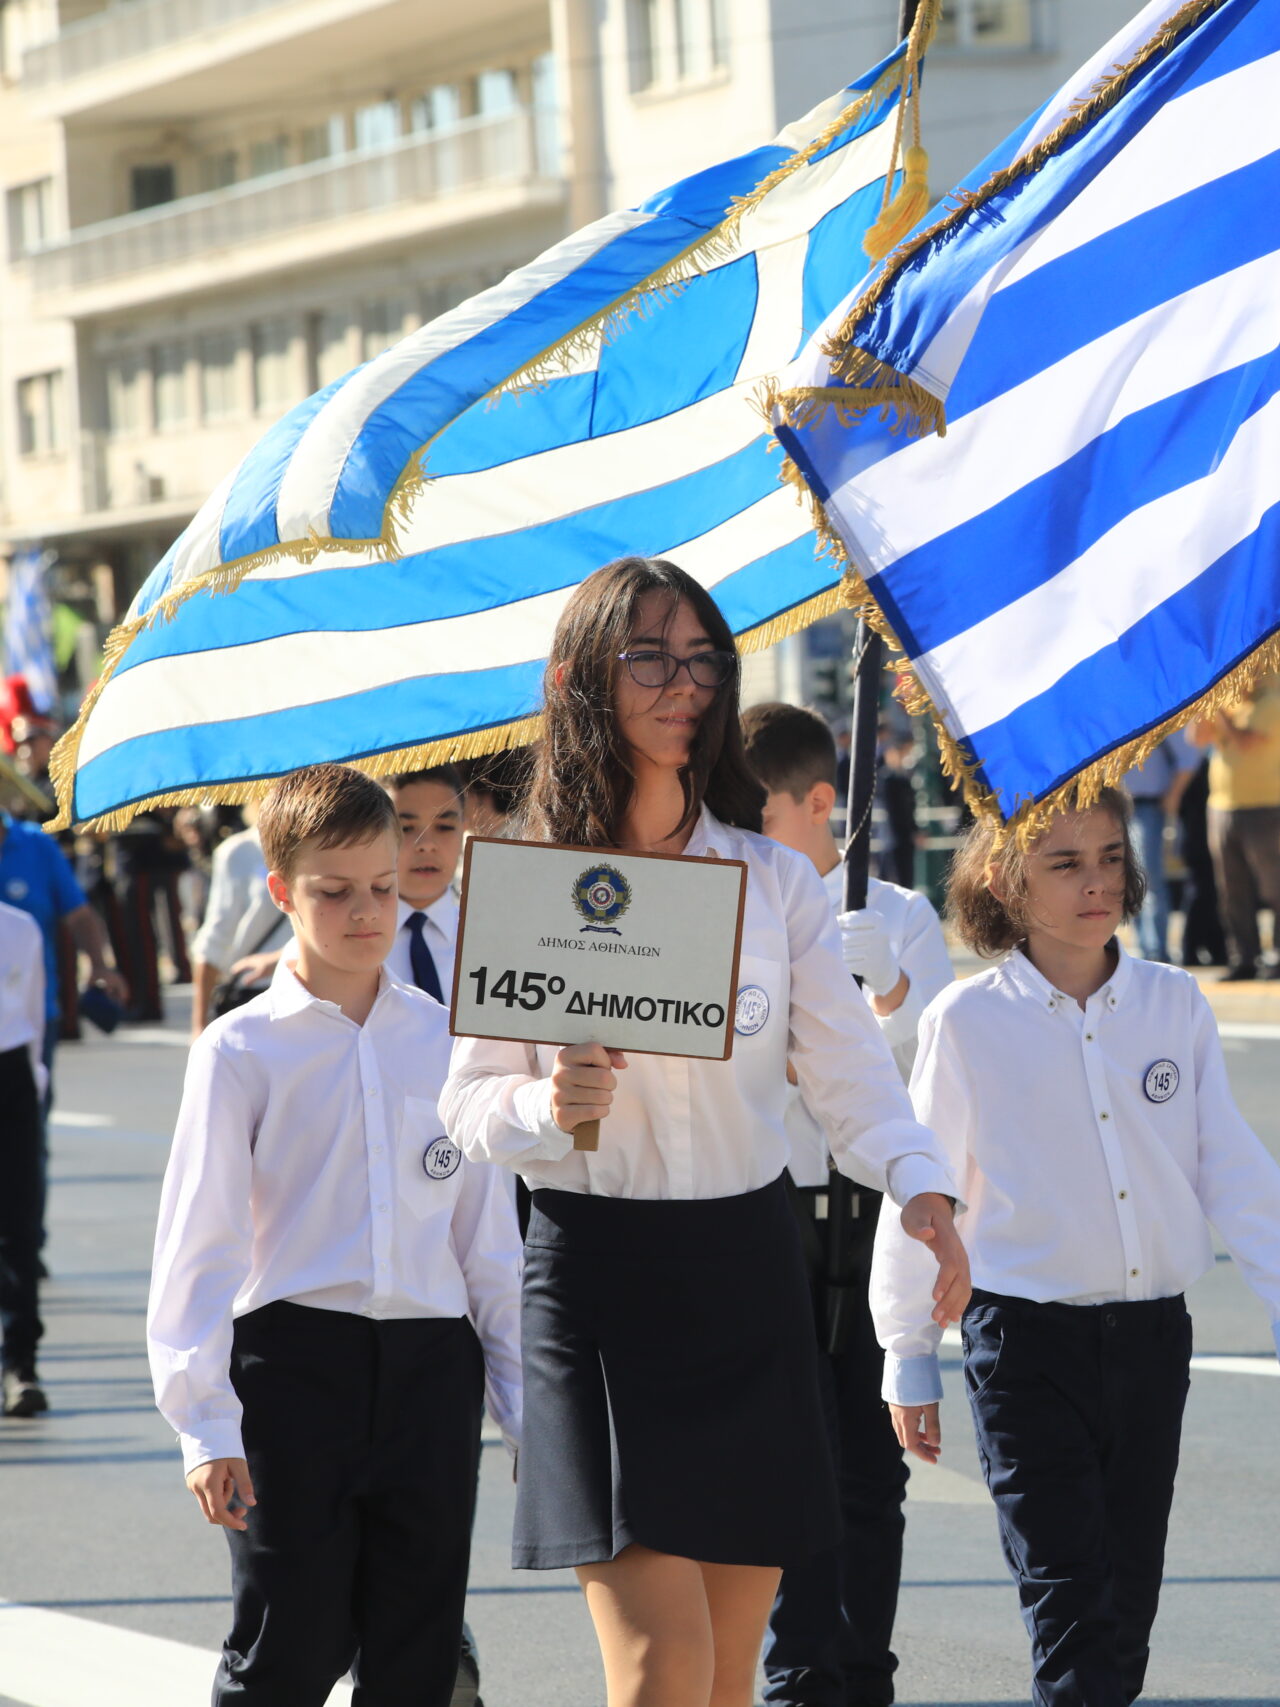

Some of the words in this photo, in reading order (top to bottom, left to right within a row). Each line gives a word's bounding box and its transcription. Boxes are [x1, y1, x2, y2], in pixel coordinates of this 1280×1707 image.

[538, 936, 586, 951] ΔΗΜΟΣ
[588, 940, 661, 958] ΑΘΗΝΑΙΩΝ
[565, 990, 725, 1028] ΔΗΜΟΤΙΚΟ
